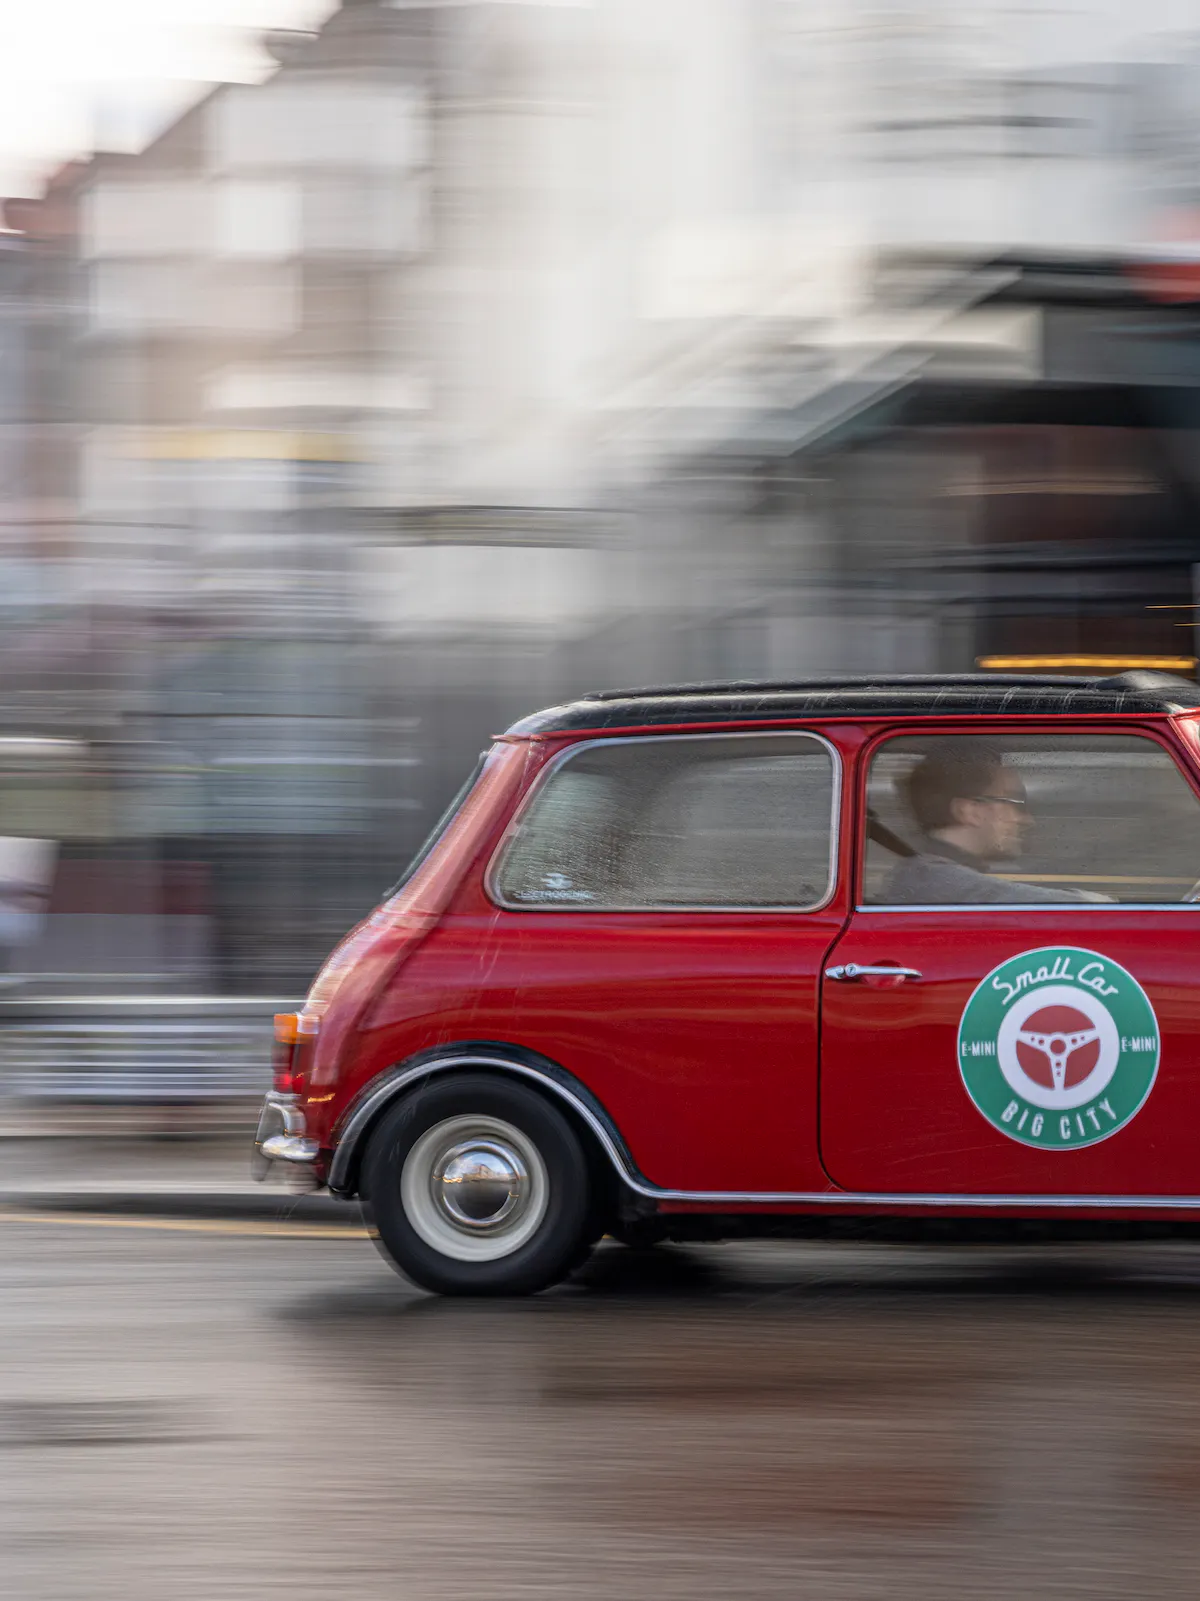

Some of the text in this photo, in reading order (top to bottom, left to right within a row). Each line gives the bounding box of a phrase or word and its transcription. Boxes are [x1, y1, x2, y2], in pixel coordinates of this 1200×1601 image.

[992, 956, 1118, 1005] Small Car
[961, 1041, 996, 1057] E-MINI
[1121, 1036, 1156, 1053] E-MINI
[1001, 1097, 1117, 1140] BIG CITY
